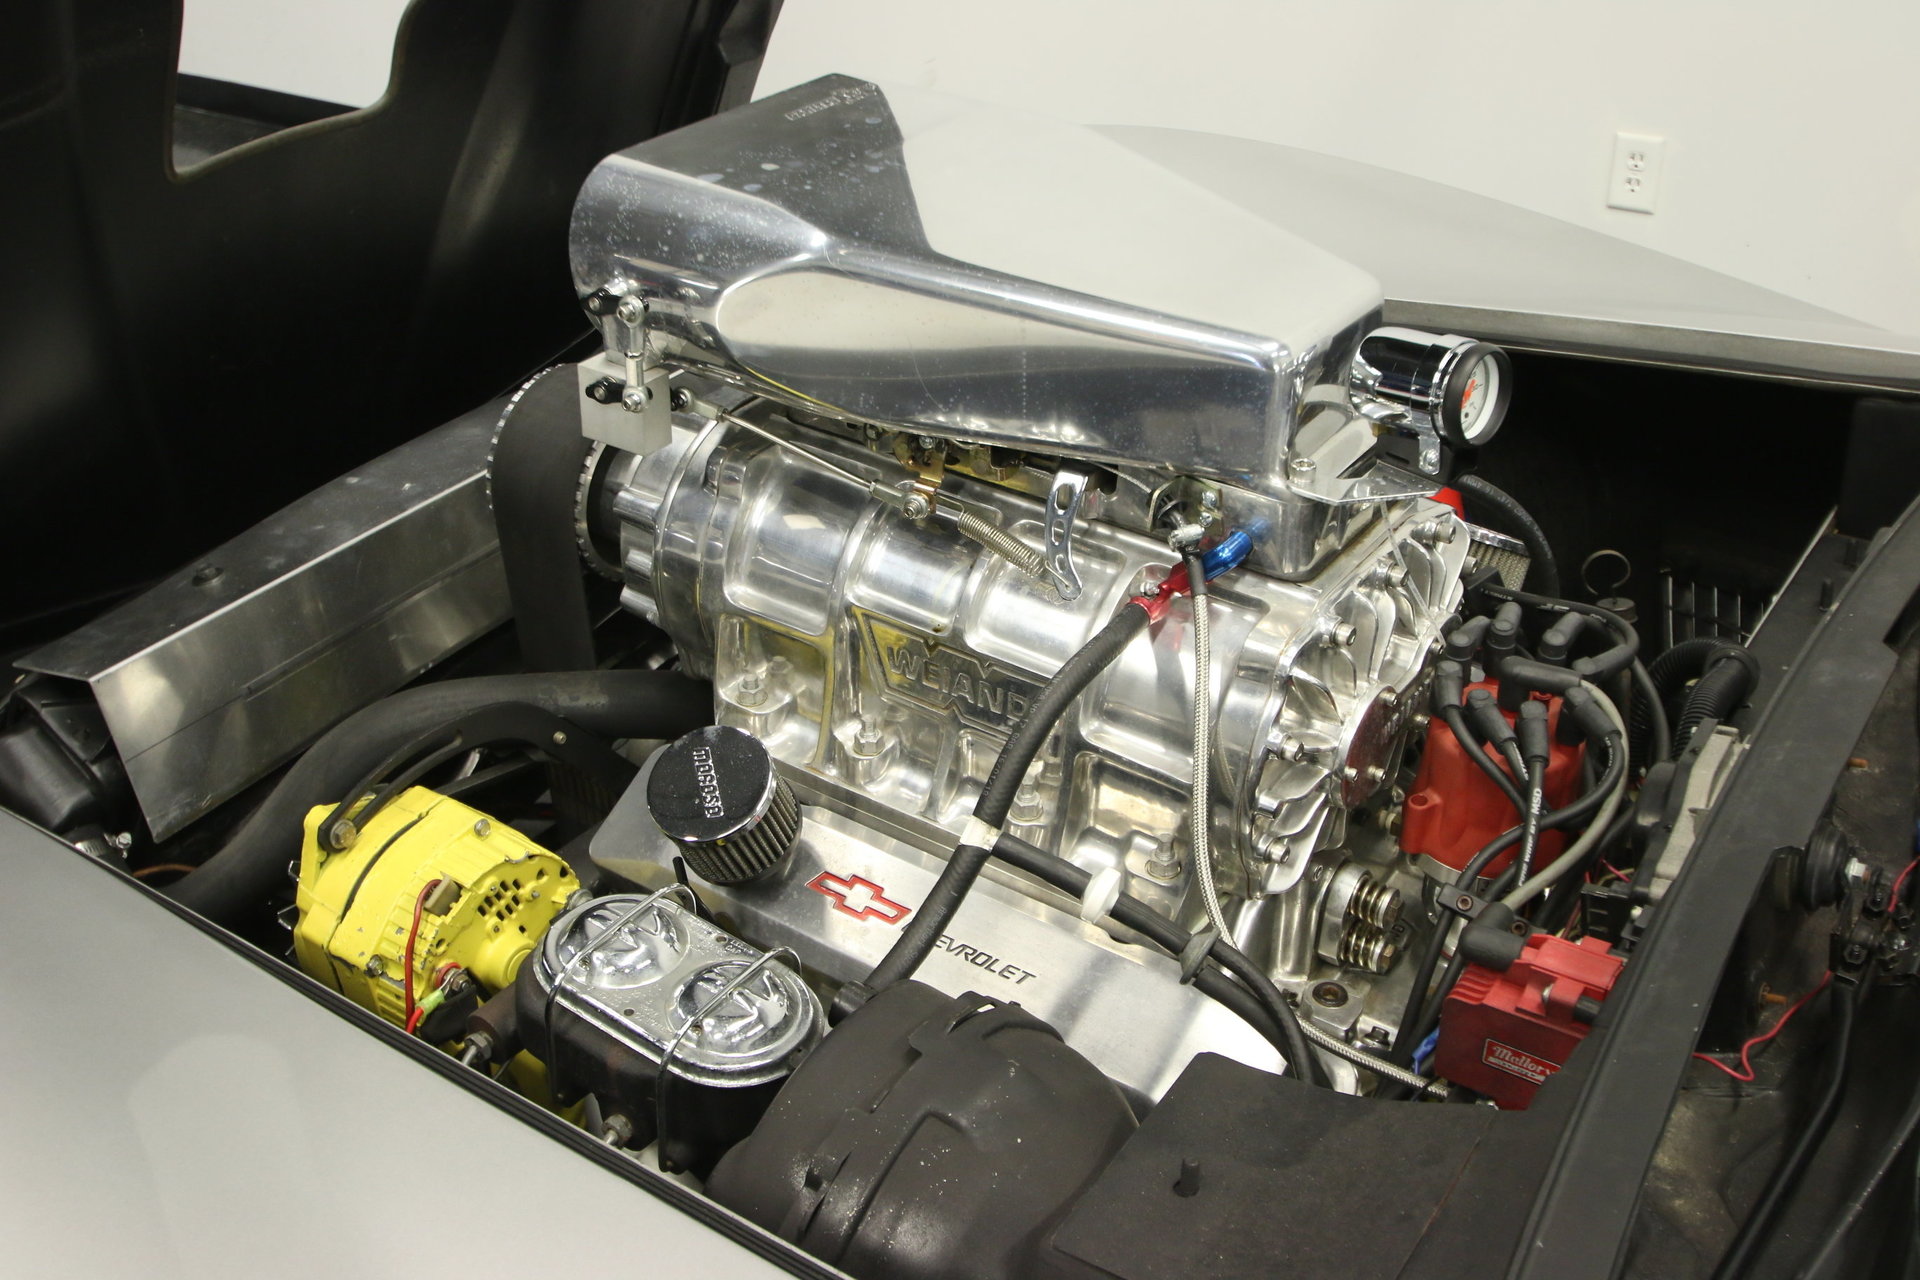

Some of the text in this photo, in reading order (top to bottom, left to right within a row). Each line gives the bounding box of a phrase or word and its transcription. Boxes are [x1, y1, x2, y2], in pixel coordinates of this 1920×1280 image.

[887, 645, 1031, 721] WEIAND
[692, 746, 724, 818] MOROSO
[1531, 788, 1543, 814] MSD
[901, 923, 1037, 985] EVROLET
